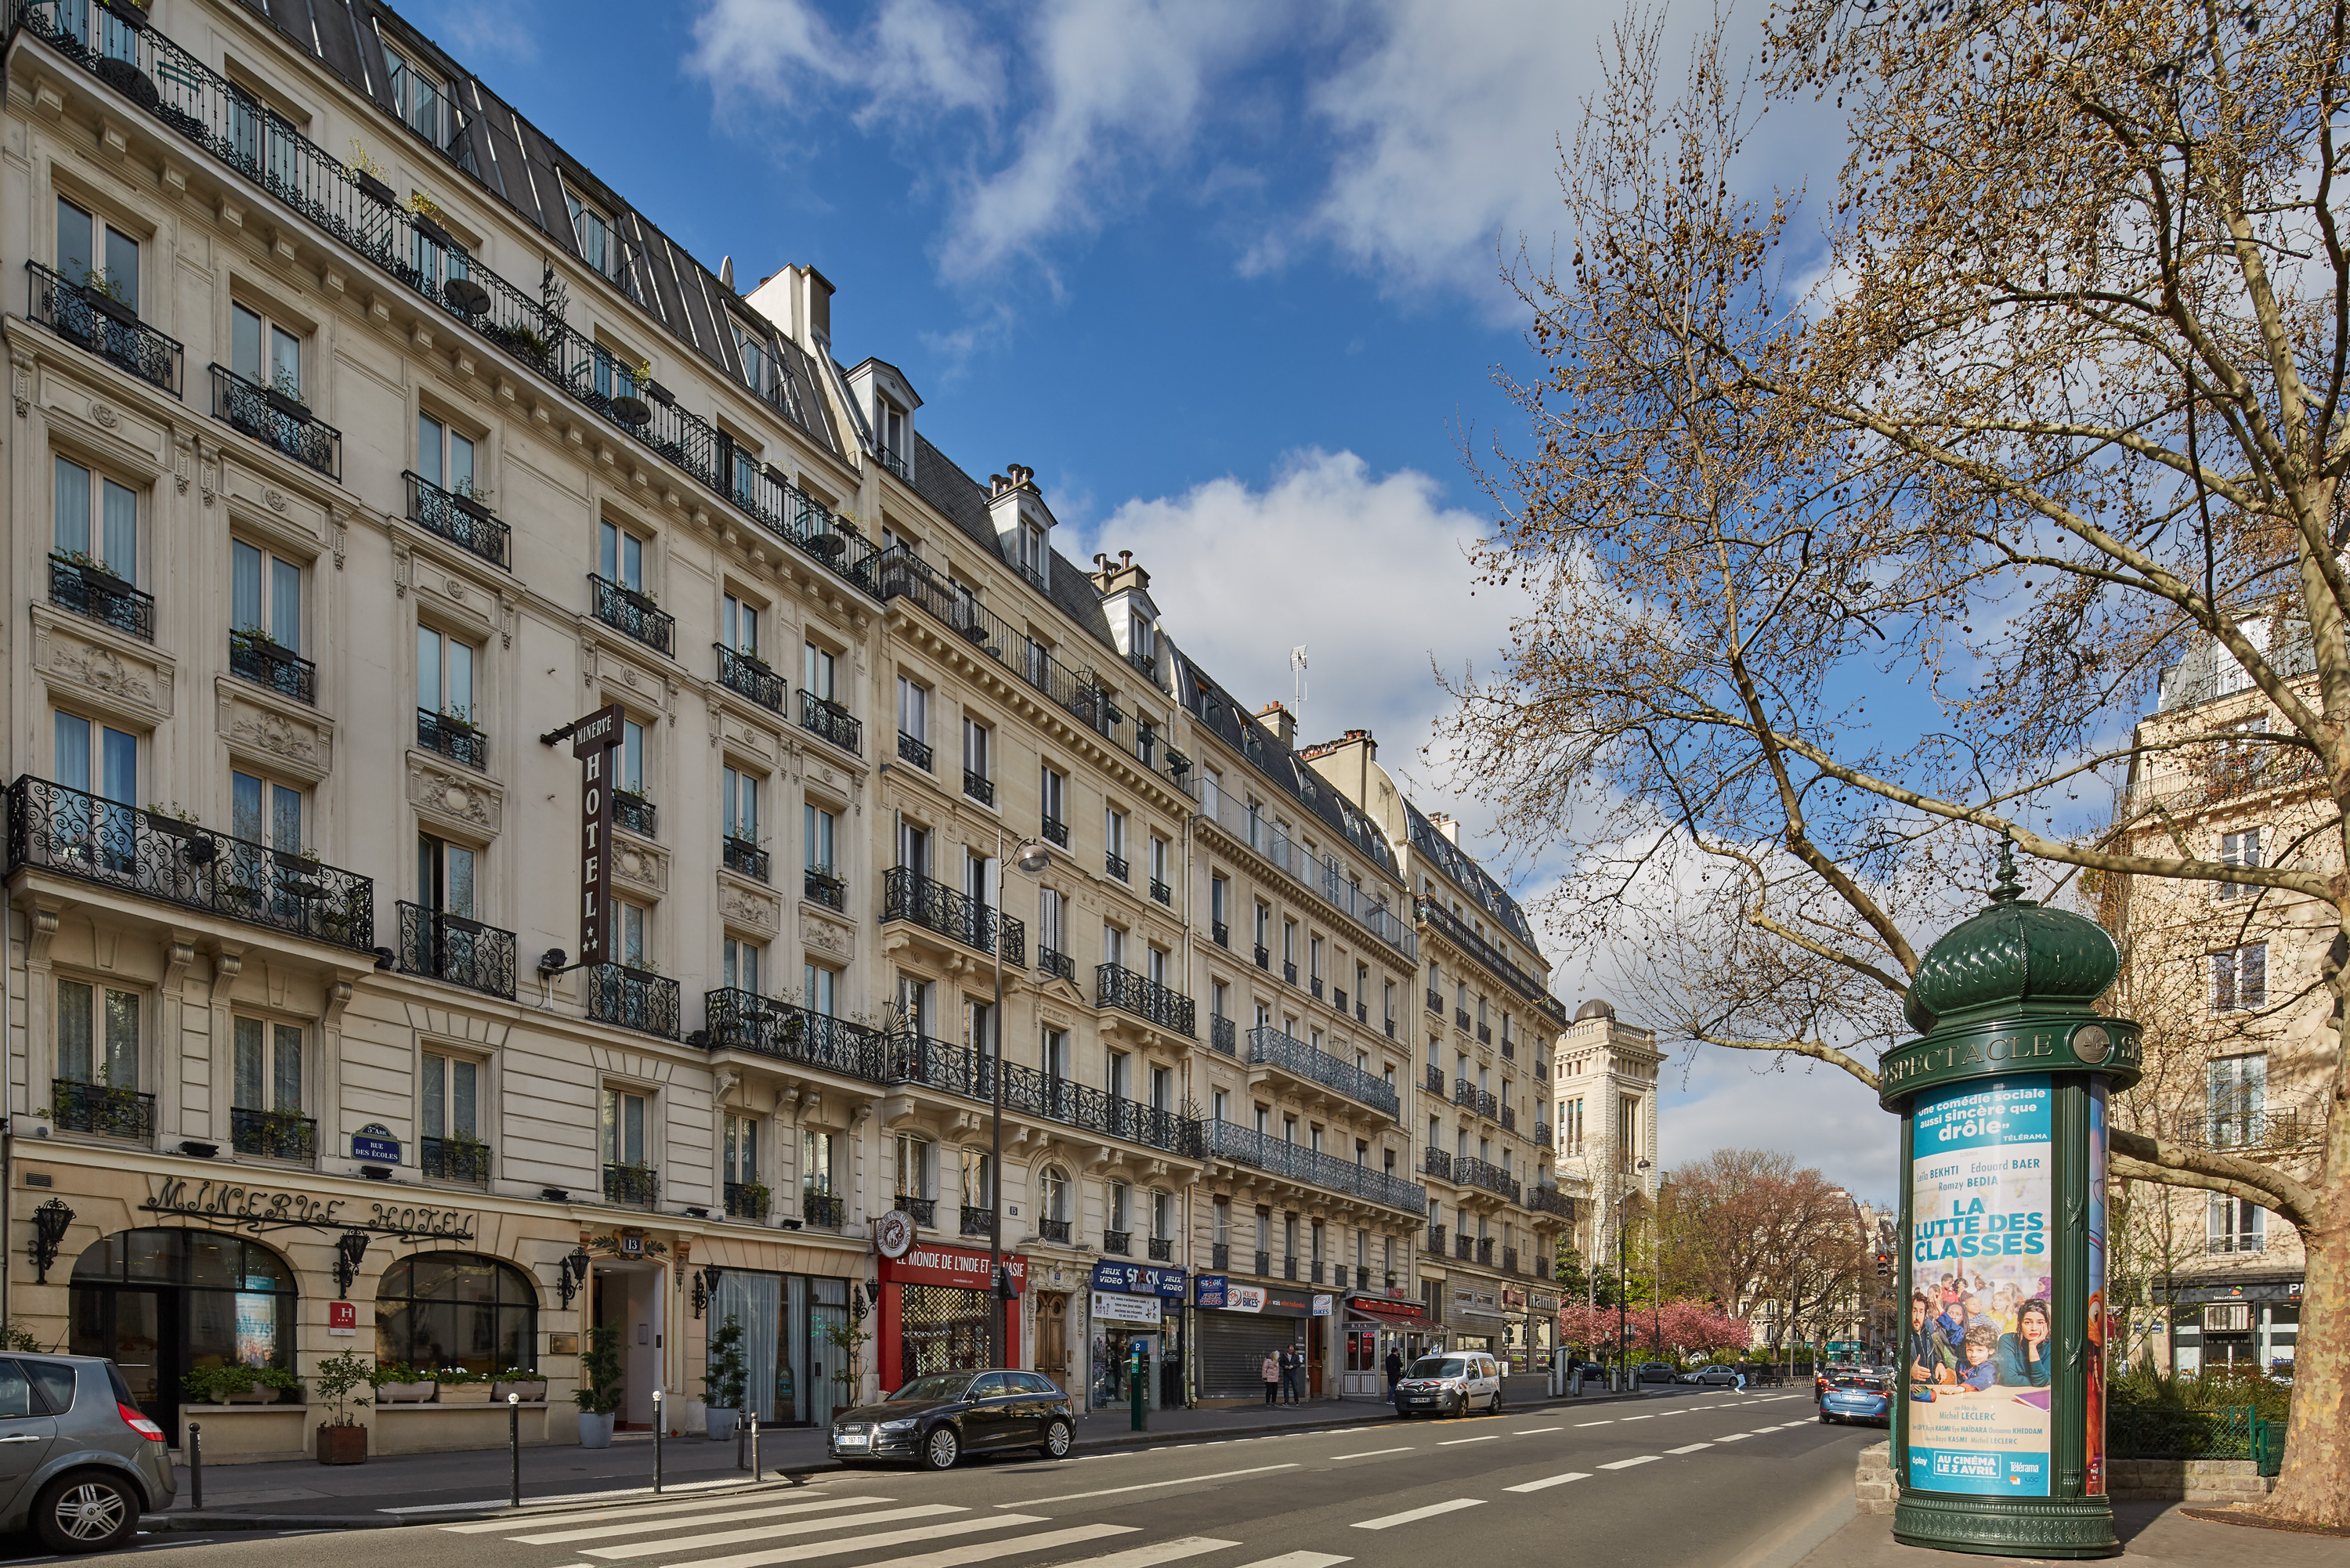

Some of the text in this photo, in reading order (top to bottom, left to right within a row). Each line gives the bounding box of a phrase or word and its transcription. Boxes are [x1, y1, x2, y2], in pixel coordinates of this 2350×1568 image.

[576, 714, 612, 746] MINERVE
[585, 752, 601, 918] HOTEL
[1889, 1034, 2054, 1085] SPECTACLE
[1936, 1094, 1990, 1111] comédie
[1994, 1089, 2046, 1101] sociale
[1920, 1104, 2037, 1129] aussi sincère que
[2003, 1133, 2048, 1142] TÉLÉRAMA
[372, 1149, 398, 1160] ÉCOLES
[1917, 1158, 2041, 1183] Leïla BEKHTI Edouard BAER
[1939, 1176, 1998, 1192] Ramzy BEDIA
[1953, 1198, 1986, 1216] LA
[369, 1203, 474, 1236] HOTEL
[1915, 1212, 2044, 1241] LUTTE DES
[627, 1240, 638, 1250] 13
[1914, 1232, 2045, 1263] CLASSES
[909, 1251, 940, 1269] MONDE
[942, 1254, 953, 1270] DE
[954, 1255, 979, 1273] L'INDE
[980, 1259, 989, 1274] ET
[1101, 1267, 1121, 1276] JEUX
[1164, 1275, 1182, 1284] JEUX
[342, 1308, 352, 1317] H
[1939, 1411, 1996, 1421] Michel LECLERC
[1912, 1456, 1928, 1466] 6play
[1937, 1455, 1996, 1466] AU CINÉMA
[2010, 1461, 2040, 1472] Télérama
[1937, 1464, 1997, 1476] LE 3 AVRIL
